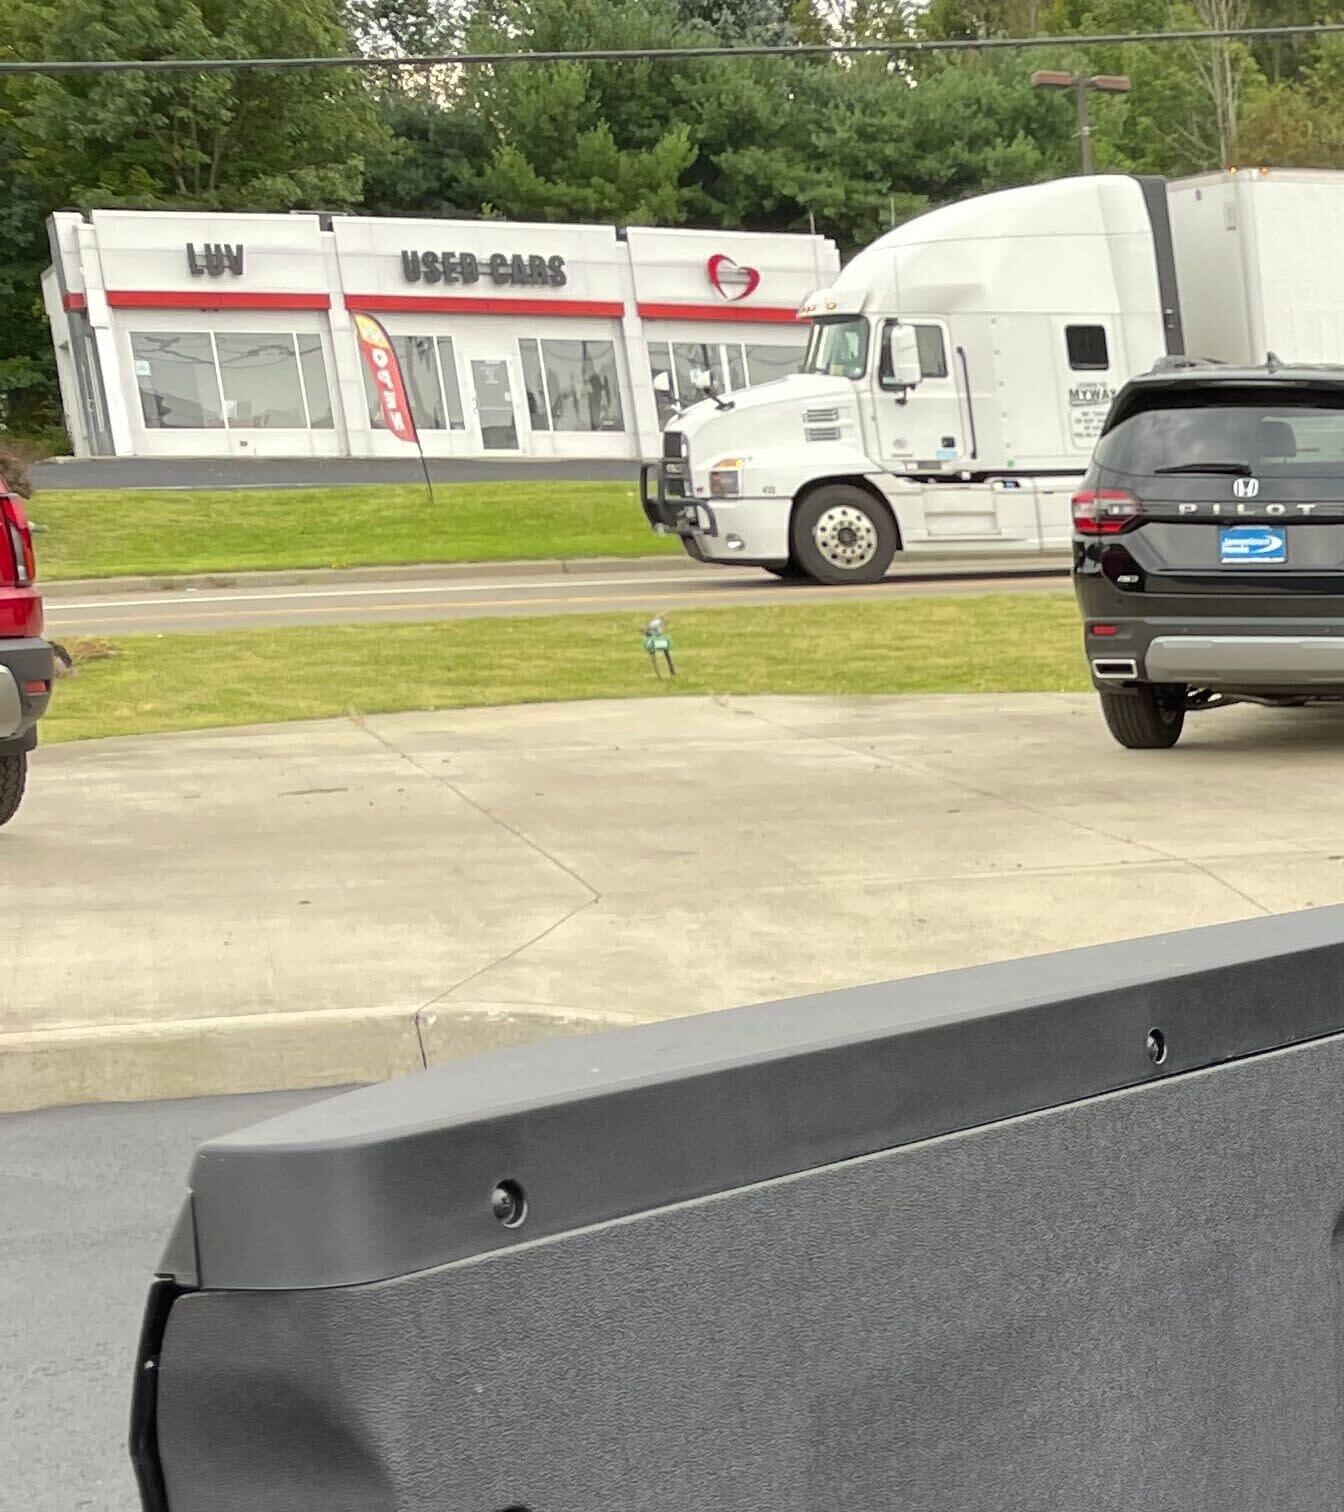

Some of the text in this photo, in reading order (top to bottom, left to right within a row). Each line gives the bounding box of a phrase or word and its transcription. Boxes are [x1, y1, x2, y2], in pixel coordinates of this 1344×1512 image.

[186, 242, 244, 276] LUV
[401, 249, 567, 287] USED CARS
[371, 347, 406, 432] OPEN
[1178, 502, 1316, 516] PILOT
